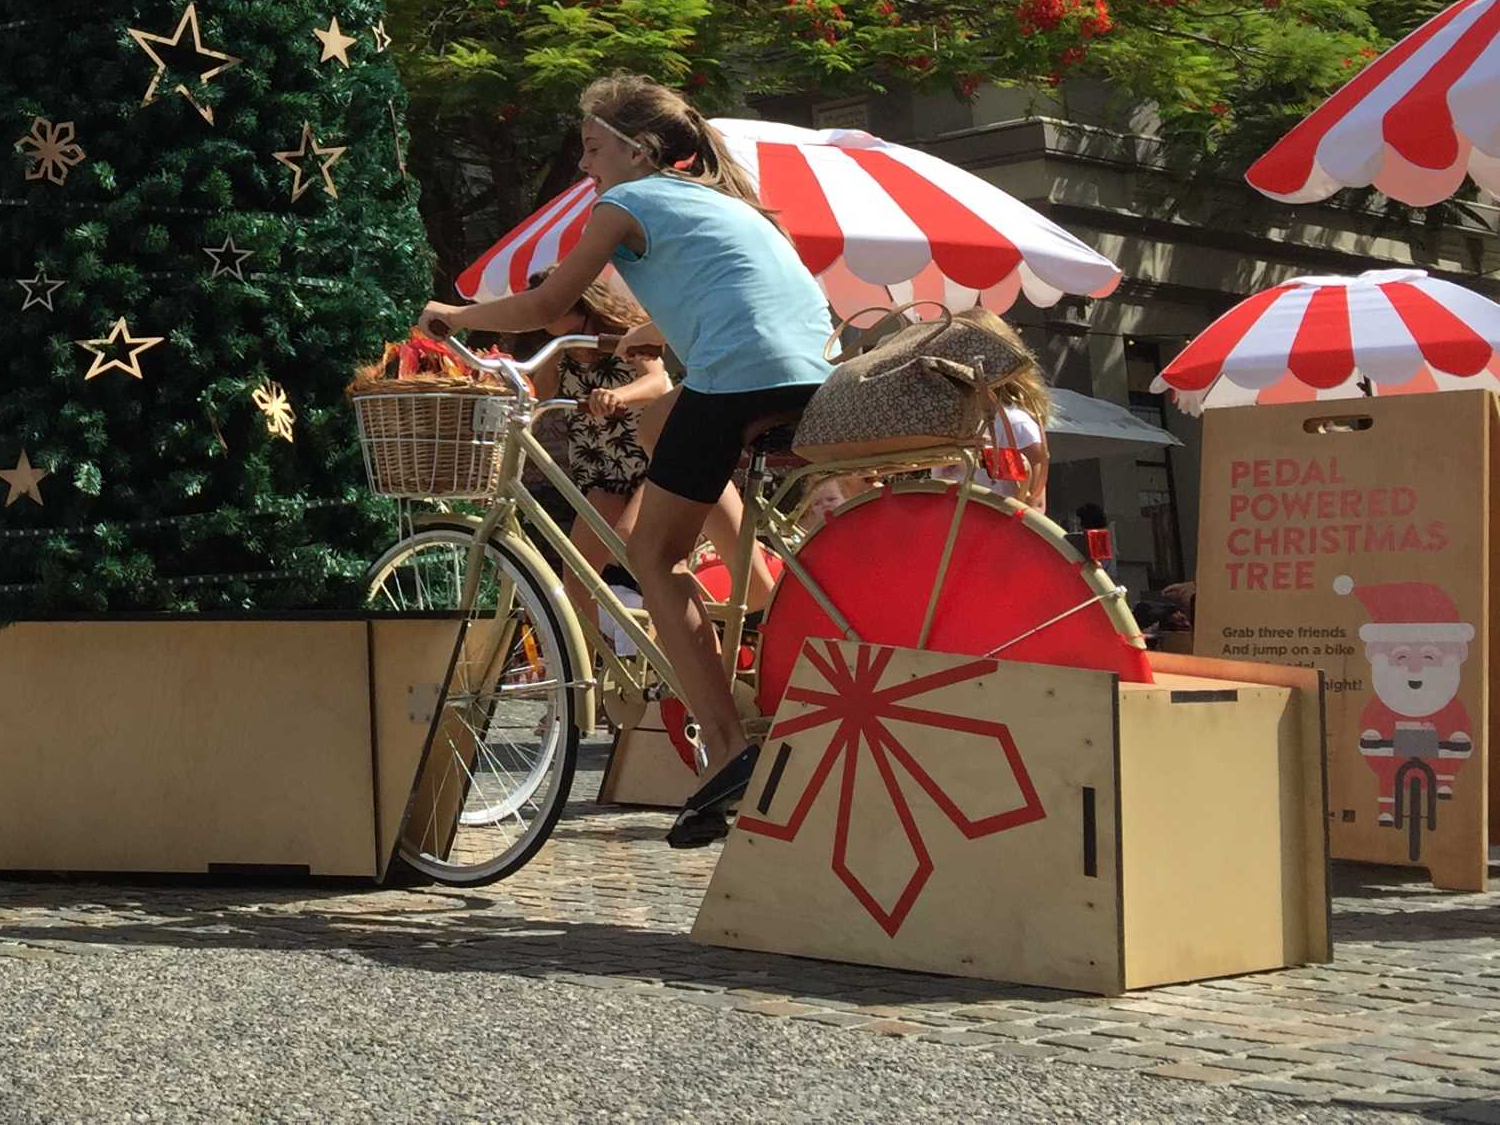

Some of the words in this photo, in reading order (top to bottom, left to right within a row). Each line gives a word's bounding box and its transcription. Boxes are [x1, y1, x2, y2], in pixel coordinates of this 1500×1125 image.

[1230, 456, 1345, 489] PEDAL
[1228, 486, 1418, 523] POWERED
[1226, 521, 1450, 557] CHRISTMAS
[1226, 561, 1315, 591] TREE
[1222, 626, 1254, 638] Grab
[1258, 626, 1294, 638] three
[1298, 626, 1347, 638] friends
[1222, 643, 1250, 655] And
[1252, 643, 1288, 657] jump
[1291, 645, 1309, 655] on
[1313, 645, 1322, 655] a
[1325, 643, 1355, 655] bike
